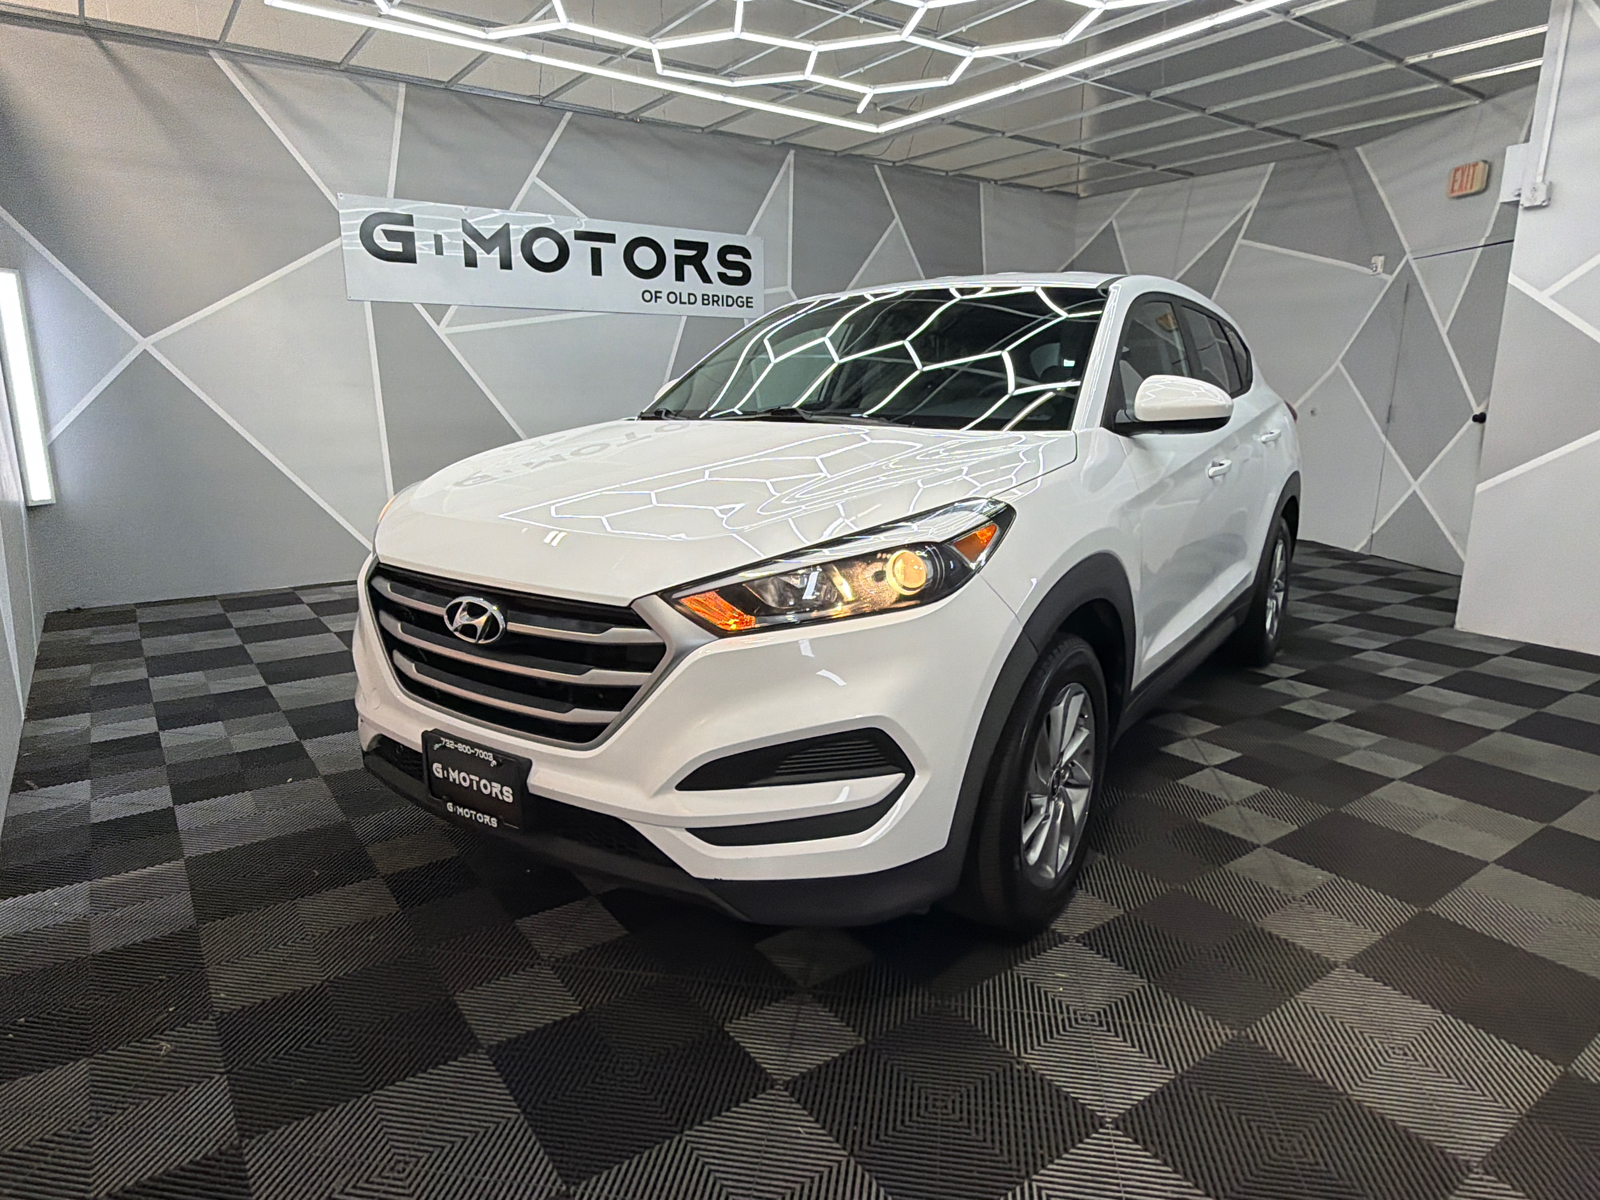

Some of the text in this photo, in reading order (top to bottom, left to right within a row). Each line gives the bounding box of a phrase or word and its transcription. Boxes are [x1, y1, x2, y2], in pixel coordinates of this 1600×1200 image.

[1450, 162, 1479, 195] EXIT
[641, 289, 754, 309] OF OLD BRIDGE
[440, 736, 494, 762] 732-800-7003
